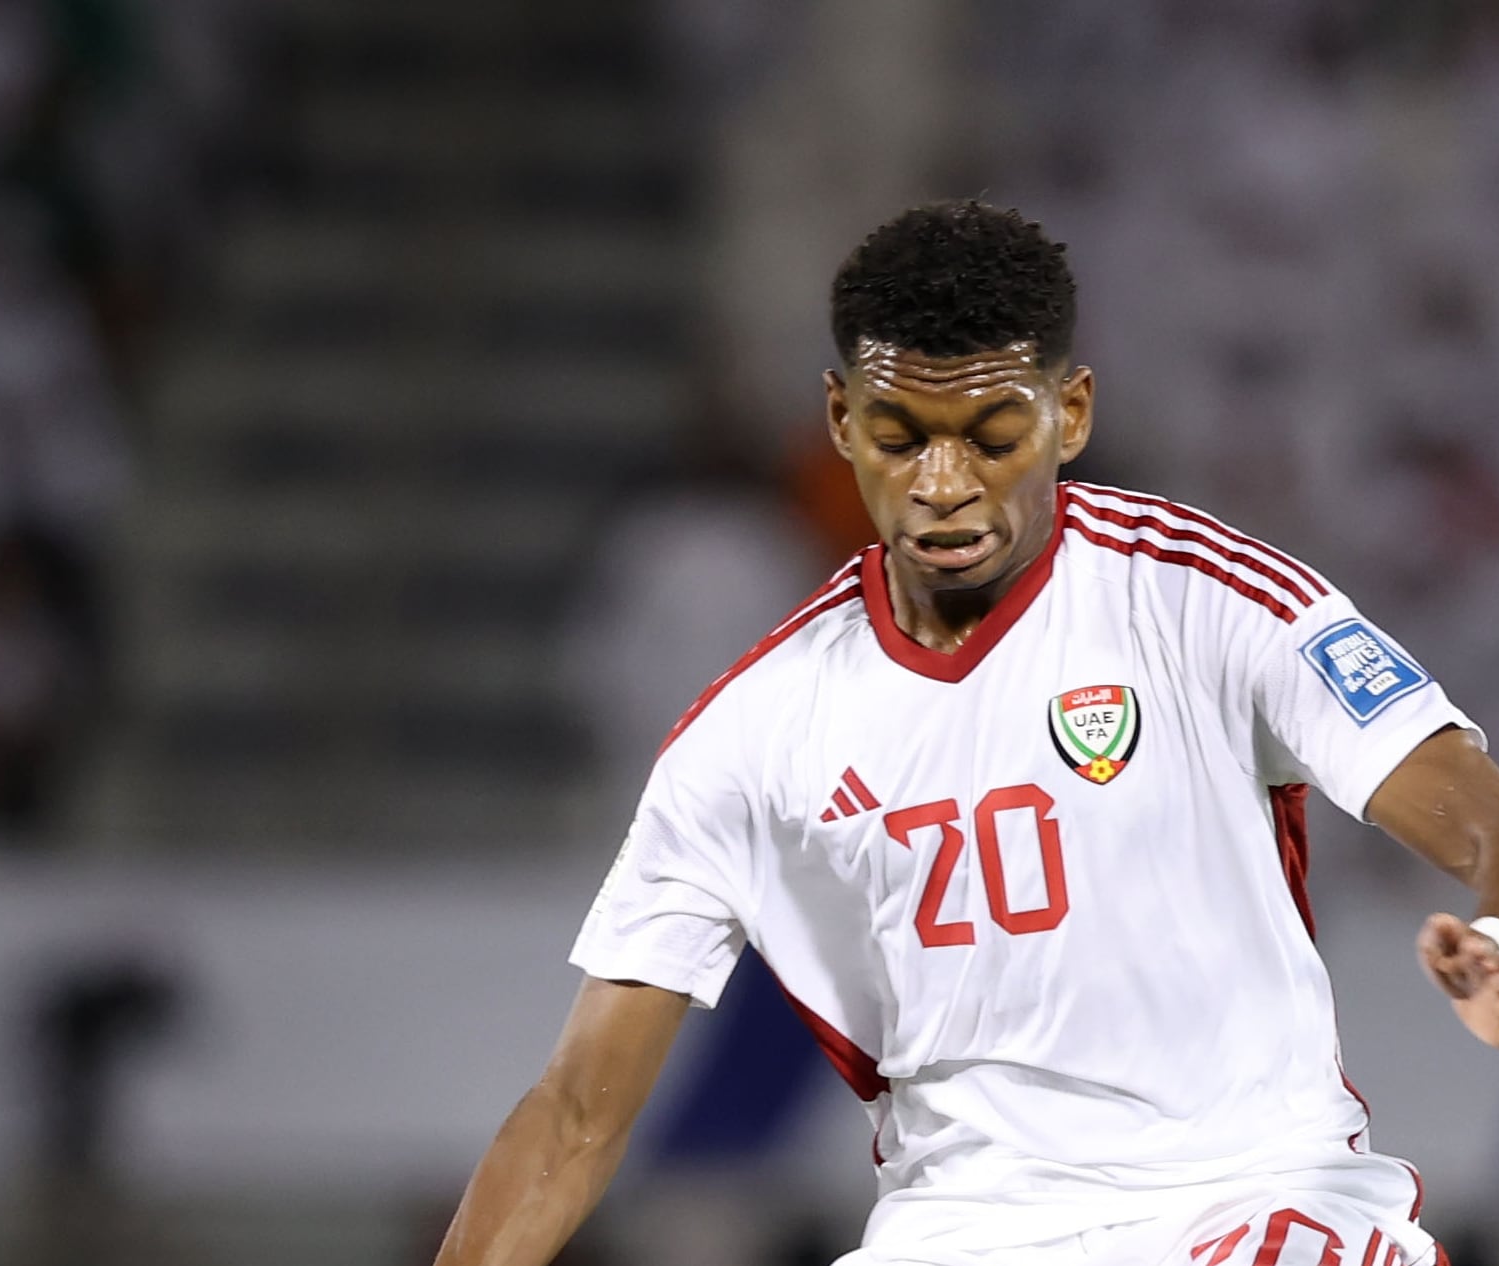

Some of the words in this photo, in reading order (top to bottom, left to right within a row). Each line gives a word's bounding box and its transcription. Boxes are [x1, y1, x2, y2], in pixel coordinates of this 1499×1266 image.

[1074, 711, 1115, 727] UAE
[1085, 727, 1109, 740] FA
[882, 782, 1070, 949] 20
